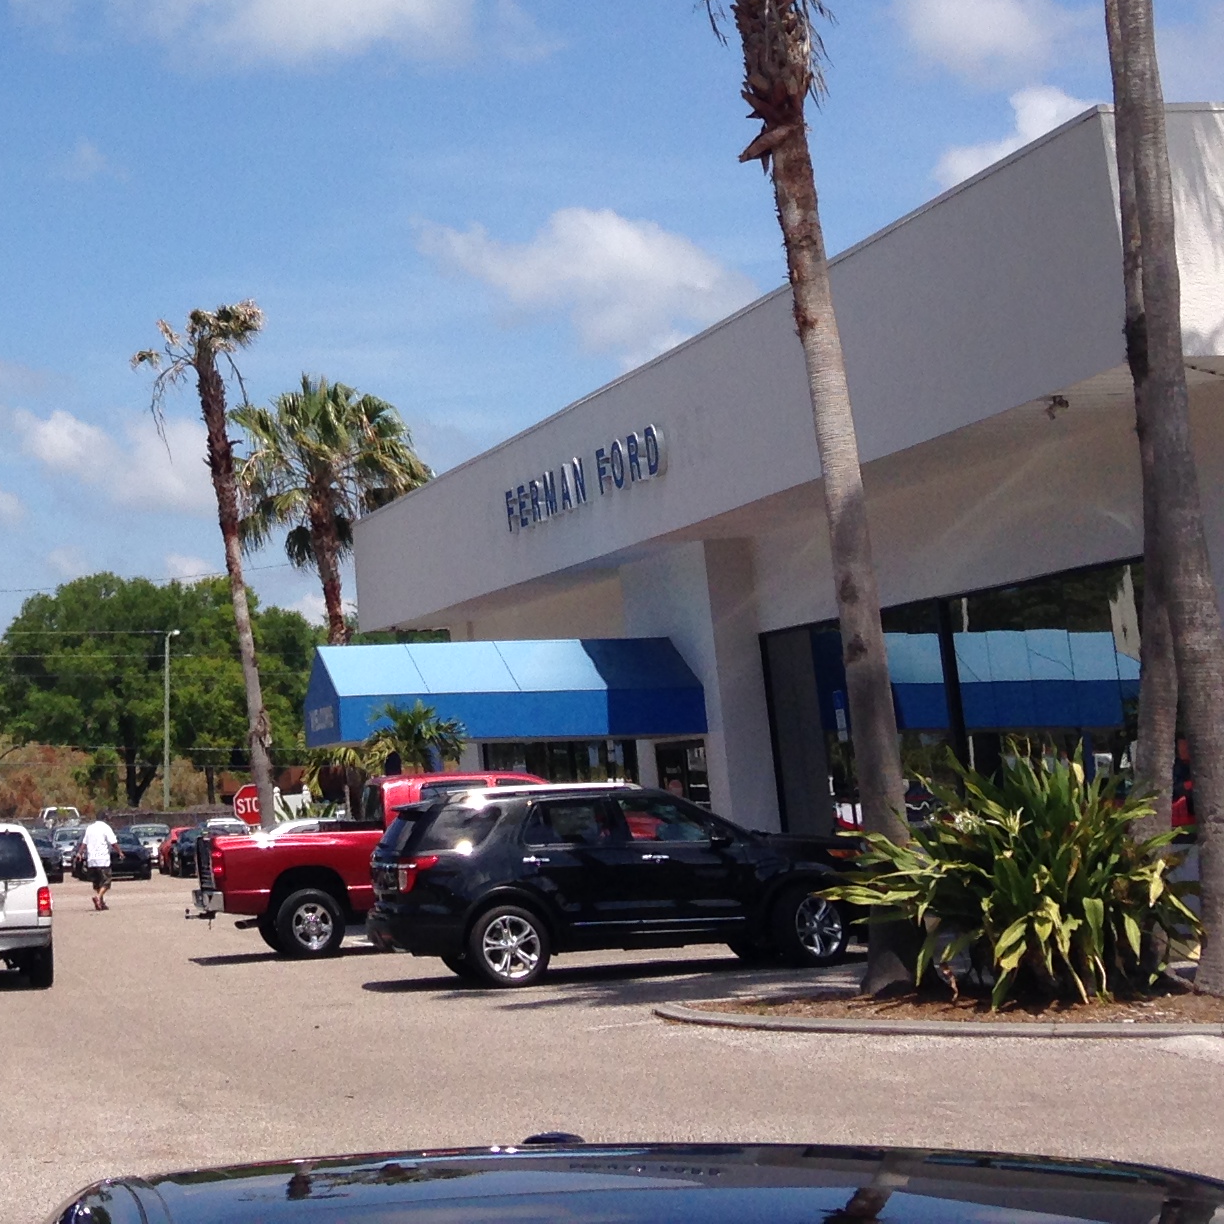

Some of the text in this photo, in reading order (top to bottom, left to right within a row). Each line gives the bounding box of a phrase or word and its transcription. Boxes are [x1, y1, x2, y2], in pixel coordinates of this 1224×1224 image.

[505, 424, 663, 532] FERMAN FORD
[237, 797, 260, 814] STO
